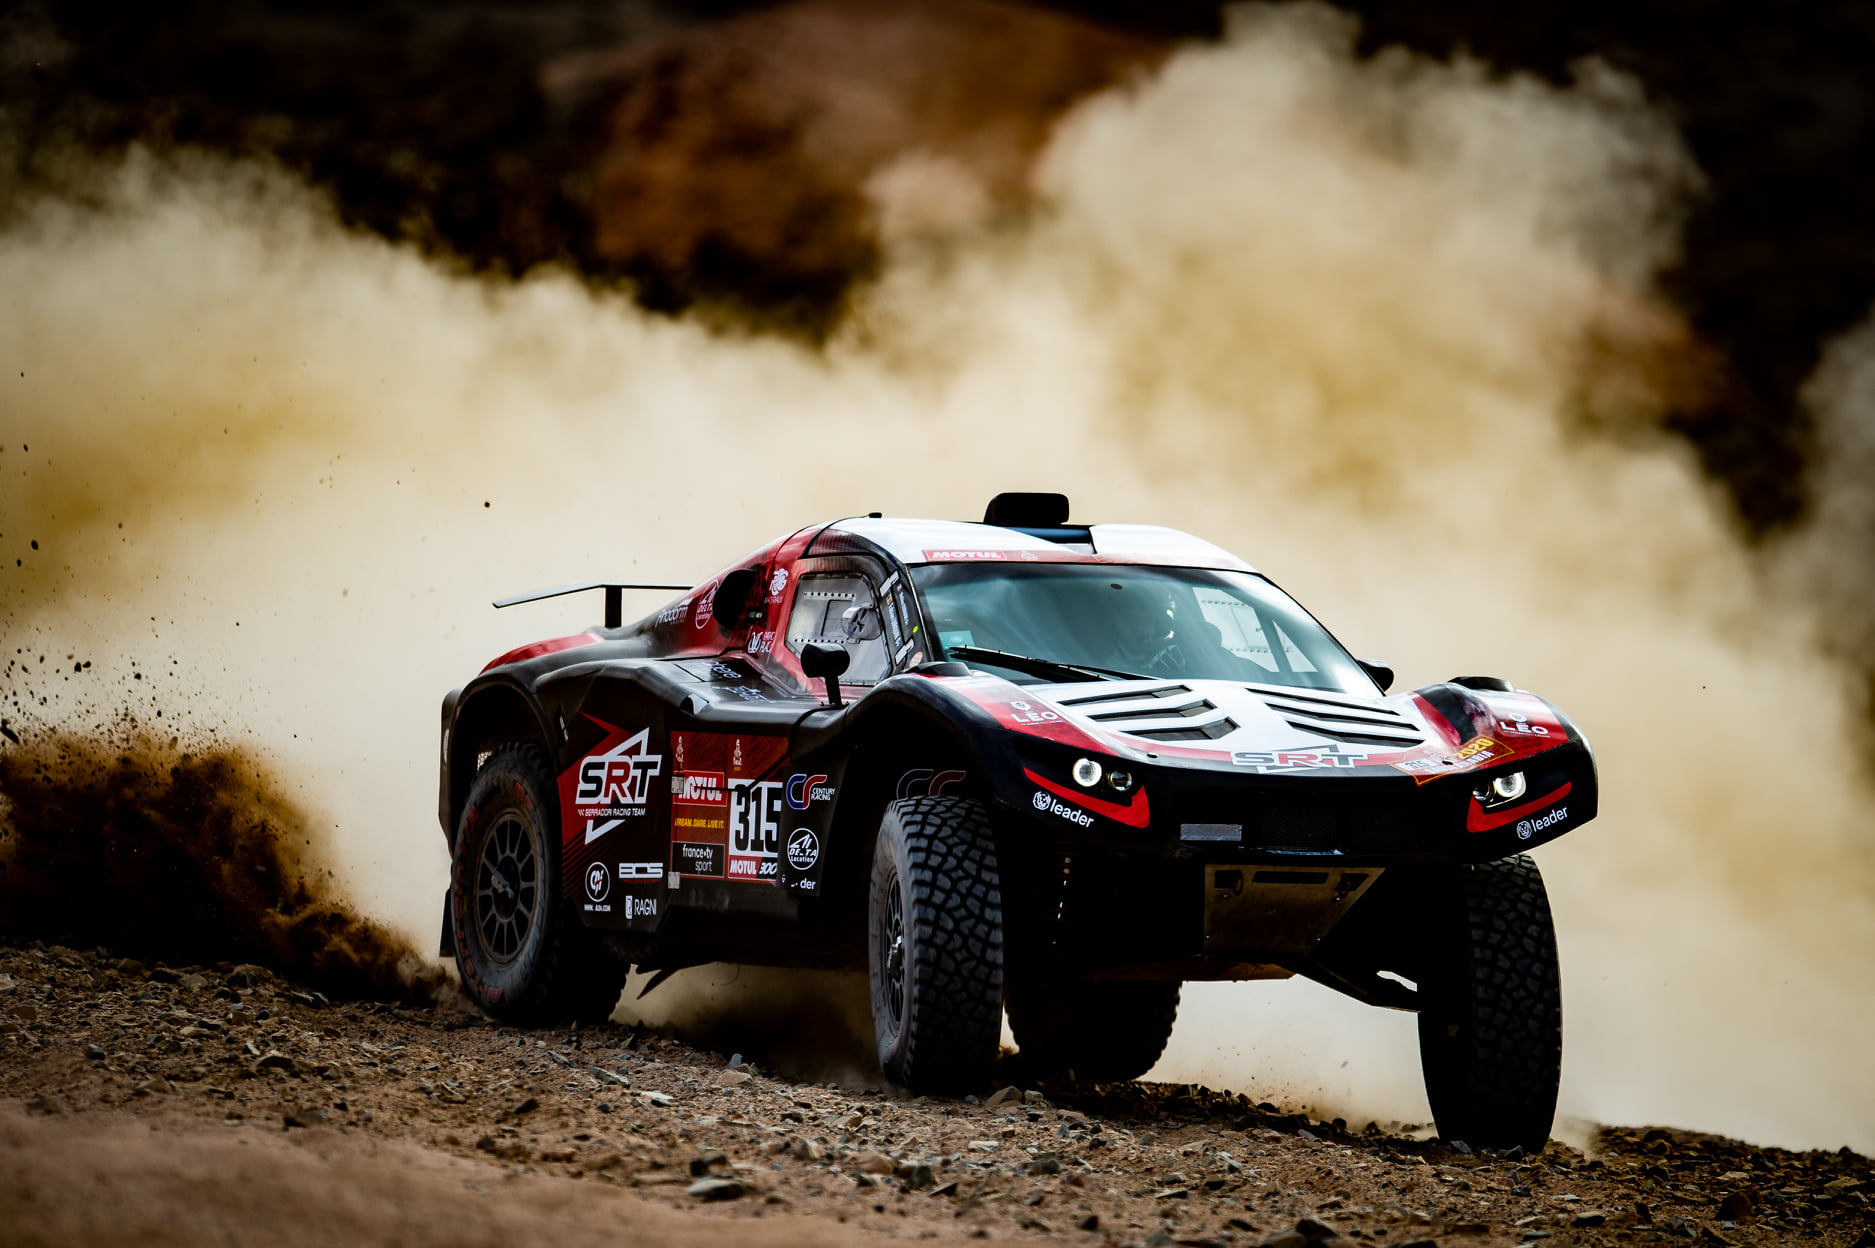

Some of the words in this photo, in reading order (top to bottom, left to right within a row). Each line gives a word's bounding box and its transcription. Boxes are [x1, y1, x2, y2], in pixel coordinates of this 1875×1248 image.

[1453, 738, 1495, 759] 2020
[1230, 751, 1369, 768] SRT
[575, 754, 662, 804] SRT
[811, 793, 831, 801] RACING
[812, 787, 835, 795] CENTURY
[632, 808, 646, 816] TEAM
[734, 783, 781, 853] 315
[1050, 799, 1094, 828] leader
[1532, 806, 1568, 832] leader
[695, 860, 713, 876] sport
[730, 860, 757, 875] MOTUL
